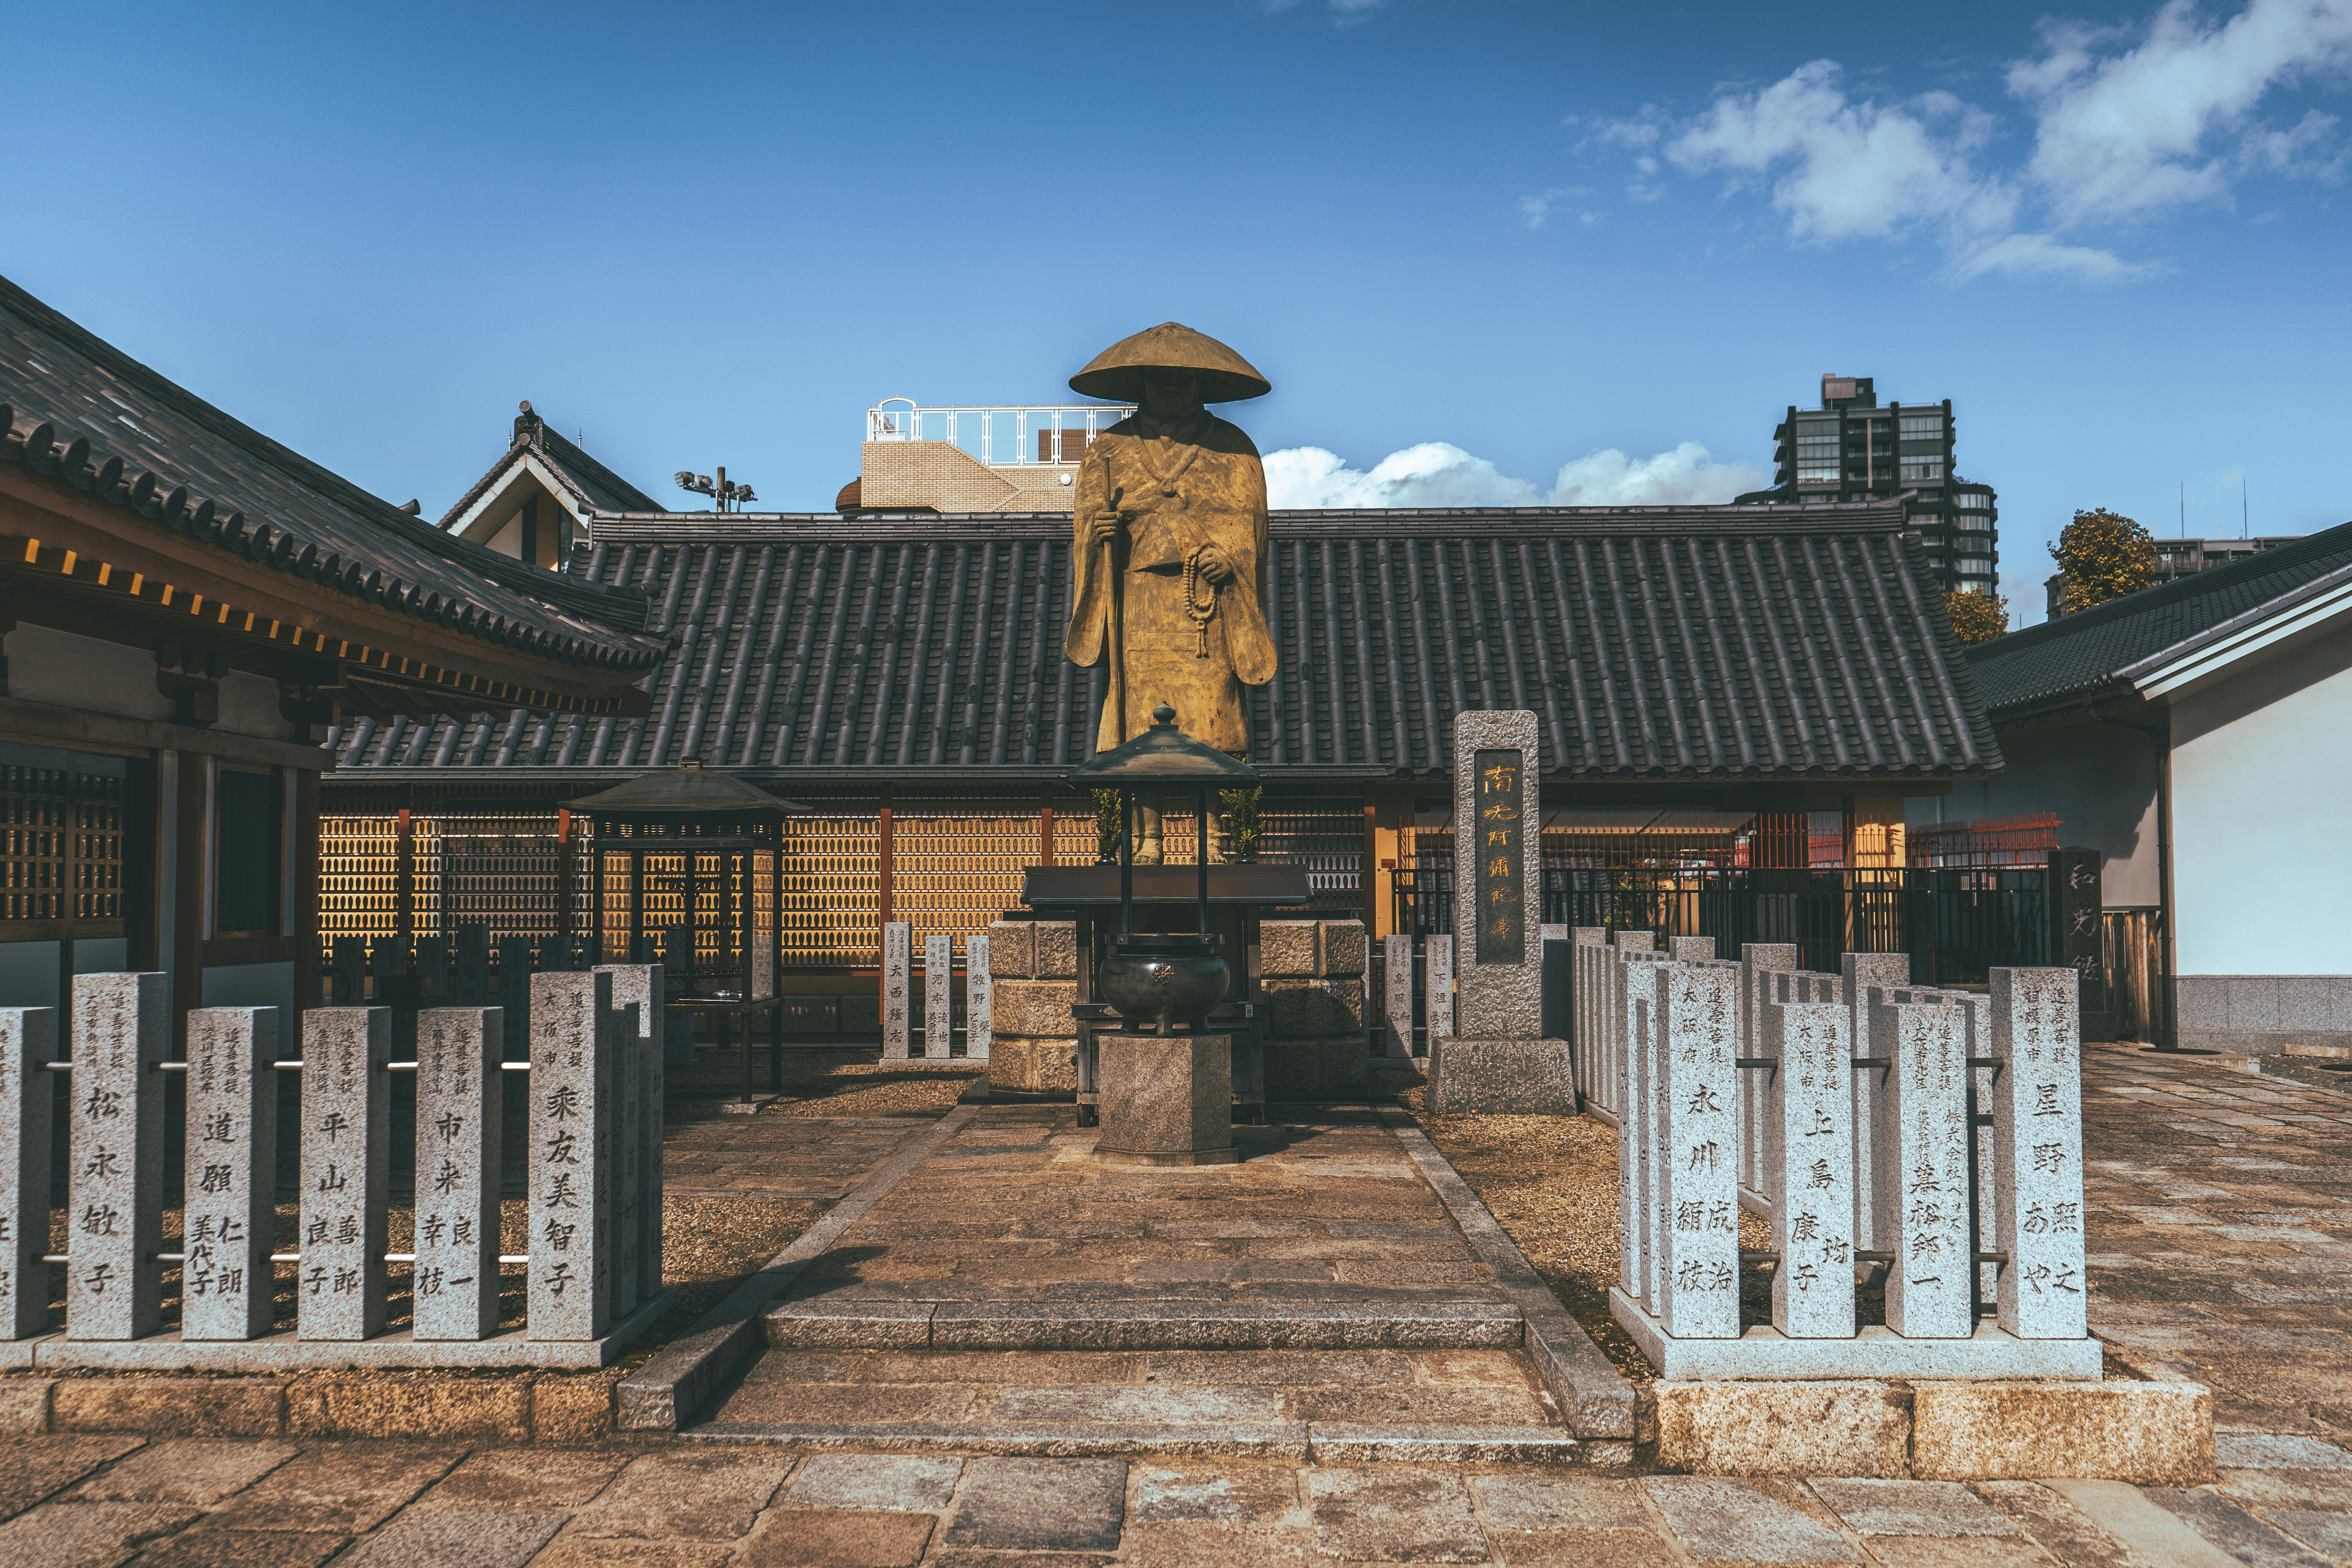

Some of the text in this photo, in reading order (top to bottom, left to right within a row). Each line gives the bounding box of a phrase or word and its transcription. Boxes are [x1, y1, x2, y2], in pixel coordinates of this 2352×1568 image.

[889, 964, 904, 1043] 大西隆志
[932, 974, 944, 1004] 河本
[938, 1011, 948, 1042] 達也
[973, 974, 985, 1004] 牧野
[1399, 1011, 1410, 1040] 和明
[1434, 972, 1447, 1003] 下垣
[1682, 987, 1698, 1064] 大阪府
[1706, 986, 1726, 1064] 追善菩提
[2025, 988, 2042, 1064] 相模原市
[2051, 986, 2070, 1064] 追善菩提
[110, 991, 127, 1069] 追善菩提
[222, 1027, 241, 1094] 追善菩提
[339, 1028, 357, 1094] 追善菩提
[453, 1028, 471, 1094] 追善菩提
[543, 992, 558, 1067] 大阪市
[568, 991, 585, 1068] 追善菩提
[1799, 1024, 1814, 1089] 大阪市
[1822, 1024, 1839, 1092] 追善菩提
[1913, 1023, 1929, 1090] 大阪市北区
[1937, 1024, 1953, 1091] 追善菩提
[199, 1112, 236, 1193] 道願
[318, 1112, 349, 1192] 平山
[434, 1112, 464, 1196] 市来
[1688, 1083, 1721, 1176] 永川
[1805, 1109, 1835, 1190] 上島
[2033, 1083, 2067, 1174] 星野
[82, 1087, 122, 1293] 松永敏子
[187, 1214, 216, 1295] 美代子
[216, 1216, 245, 1294] 仁朗
[304, 1214, 332, 1293] 良子
[334, 1214, 359, 1295] 善郎
[449, 1215, 476, 1286] 良一
[1676, 1200, 1706, 1292] 絹枝
[1706, 1200, 1734, 1292] 成治
[1791, 1210, 1820, 1292] 康子
[2024, 1201, 2051, 1294] あや
[2053, 1202, 2080, 1293] 照之
